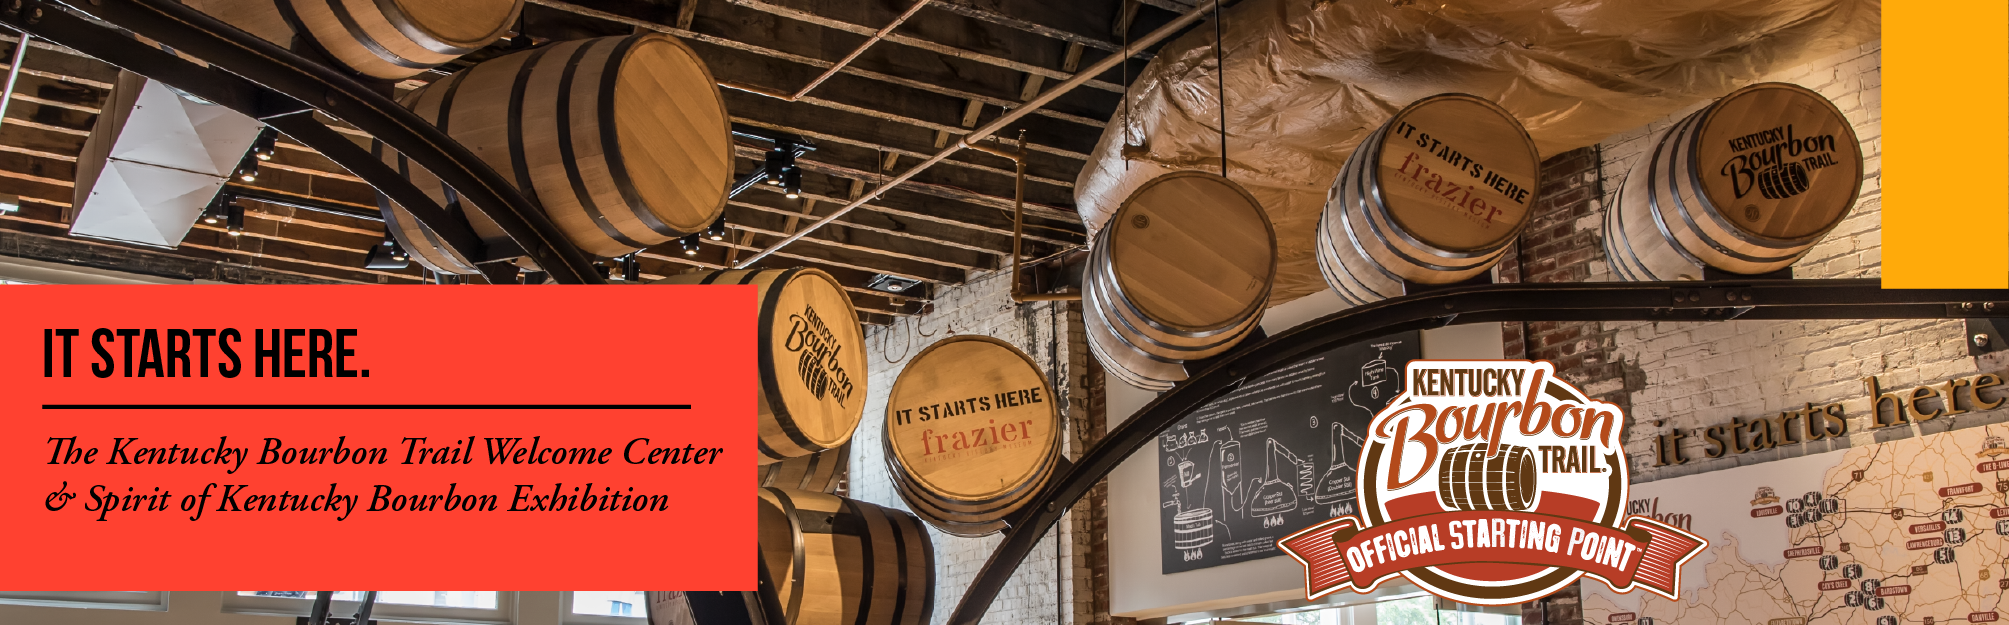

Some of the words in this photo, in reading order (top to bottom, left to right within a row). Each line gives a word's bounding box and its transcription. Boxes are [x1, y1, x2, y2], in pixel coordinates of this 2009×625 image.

[1728, 126, 1784, 153] KENTUCKY
[1396, 121, 1416, 139] IT
[1416, 132, 1483, 179] STARTS
[1483, 170, 1529, 205] HERE
[1720, 124, 1836, 200] Bourbon
[1397, 151, 1503, 224] frazier
[804, 304, 837, 350] KENTUCKY
[785, 313, 853, 400] Bourbon
[896, 408, 913, 426] IT
[918, 396, 991, 422] STARTS
[994, 387, 1043, 409] HERE
[1652, 420, 1687, 467] it
[1703, 401, 1847, 459] starts
[1862, 373, 2006, 429] here
[921, 418, 1033, 456] frazier
[1947, 485, 1974, 495] FRANKFORT
[1997, 482, 2008, 491] 75
[1788, 501, 1800, 511] 10
[1756, 508, 1778, 517] LOUISVILLE
[1893, 510, 1902, 519] 64
[1944, 511, 1958, 522] 14
[1914, 523, 1941, 533] VERSAILLES
[1949, 530, 1961, 542] 13
[1906, 539, 1942, 550] LAWRENCEBURG
[1787, 546, 1820, 557] SHEPHERDSVILLE
[1880, 586, 1908, 596] BARDSTOWN
[1971, 613, 1995, 622] DANVILLE
